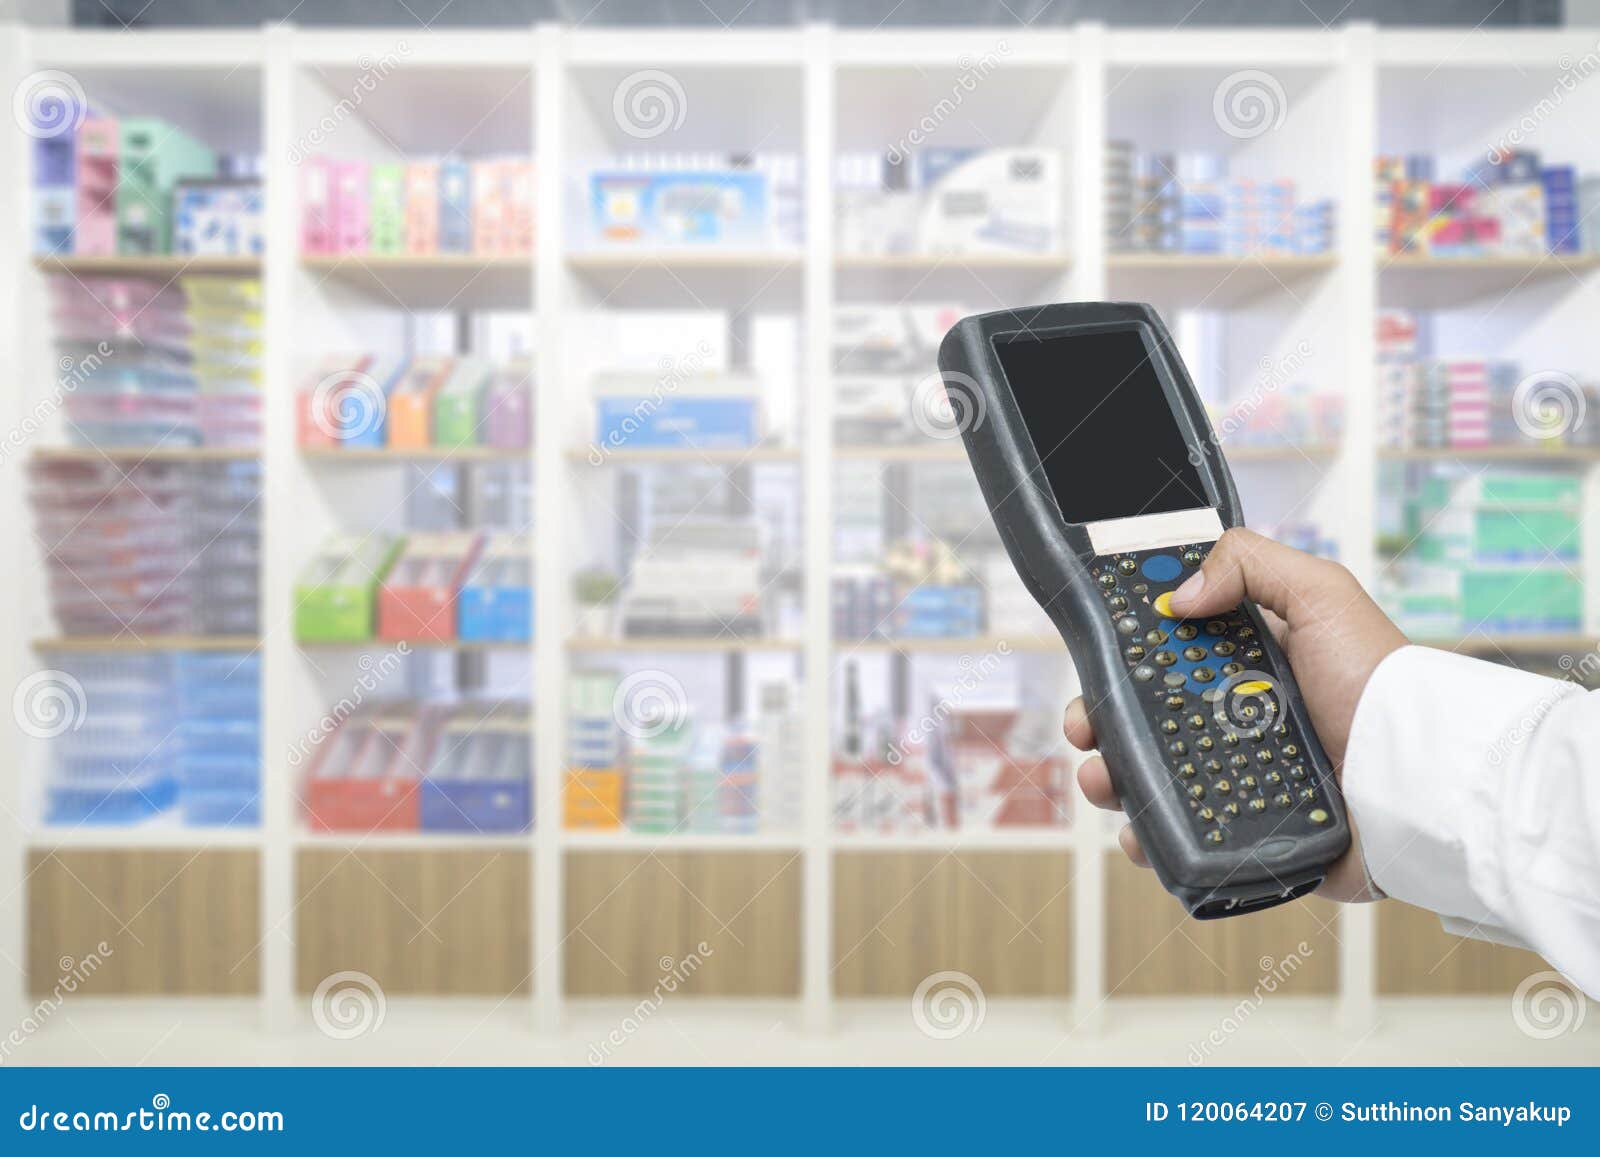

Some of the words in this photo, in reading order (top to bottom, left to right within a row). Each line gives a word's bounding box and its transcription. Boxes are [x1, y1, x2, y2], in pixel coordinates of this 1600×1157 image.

[1123, 559, 1136, 569] F3
[1103, 574, 1115, 584] F2
[1113, 596, 1125, 605] F1
[1229, 663, 1239, 674] 9
[1168, 719, 1177, 729] A
[1195, 714, 1204, 726] B
[1218, 711, 1228, 721] C
[1244, 706, 1254, 716] D
[1270, 702, 1278, 713] E
[1175, 741, 1185, 752] F
[1203, 738, 1213, 748] G
[1227, 732, 1238, 743] H
[1184, 762, 1195, 774] K
[1261, 750, 1273, 761] N
[1287, 745, 1297, 755] O
[1246, 776, 1257, 787] R
[1271, 771, 1280, 782] S
[1296, 765, 1304, 776] T
[1204, 807, 1215, 818] U
[1228, 803, 1239, 814] V
[1255, 799, 1266, 809] W
[1305, 787, 1315, 798] Y
[1213, 829, 1223, 841] Z
